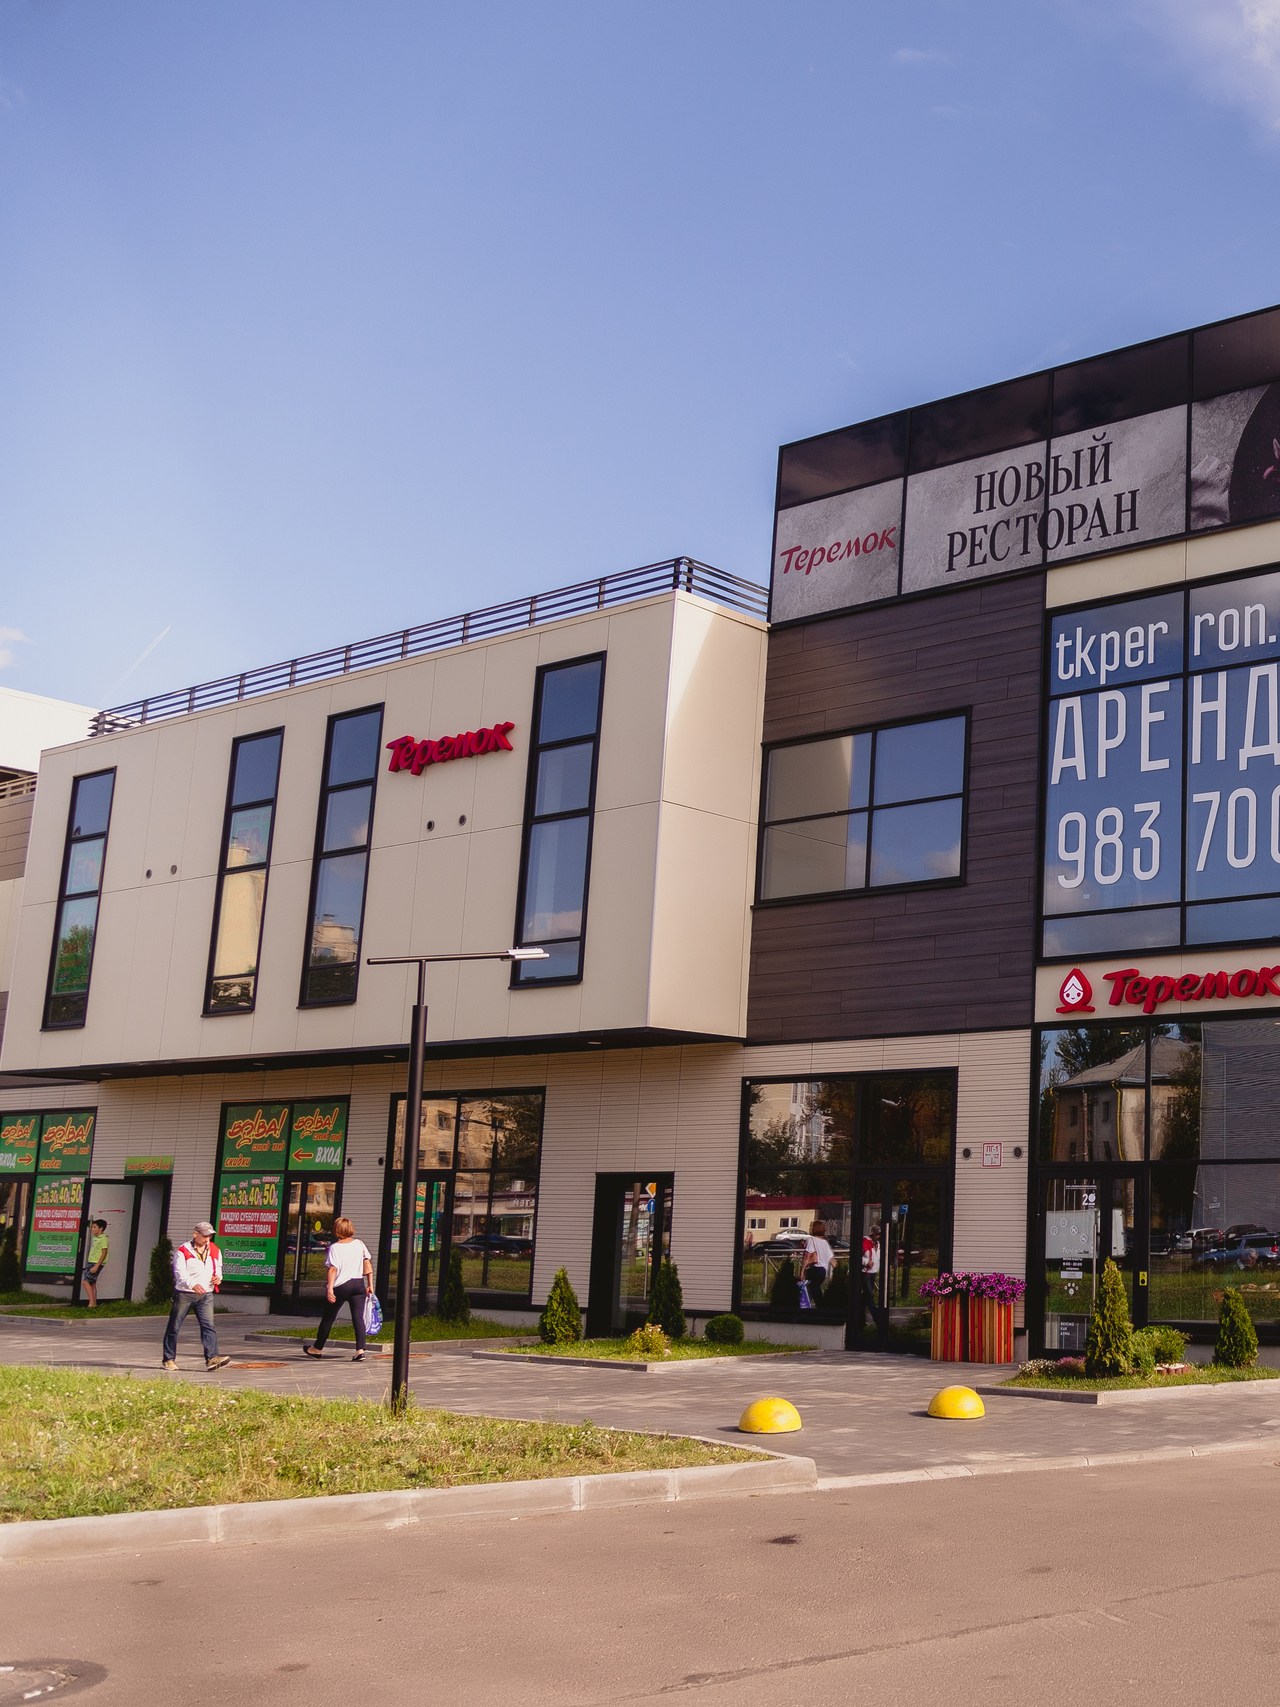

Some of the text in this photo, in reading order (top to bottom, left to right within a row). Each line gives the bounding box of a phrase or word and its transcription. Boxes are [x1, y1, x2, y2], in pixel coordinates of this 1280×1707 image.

[972, 431, 1114, 515] НОВЫЙ
[780, 525, 898, 576] Теремок
[946, 490, 1140, 574] РЕСТОРАН
[385, 721, 515, 776] Теремок
[1057, 801, 1161, 888] 983
[315, 1147, 341, 1165] ВХОД
